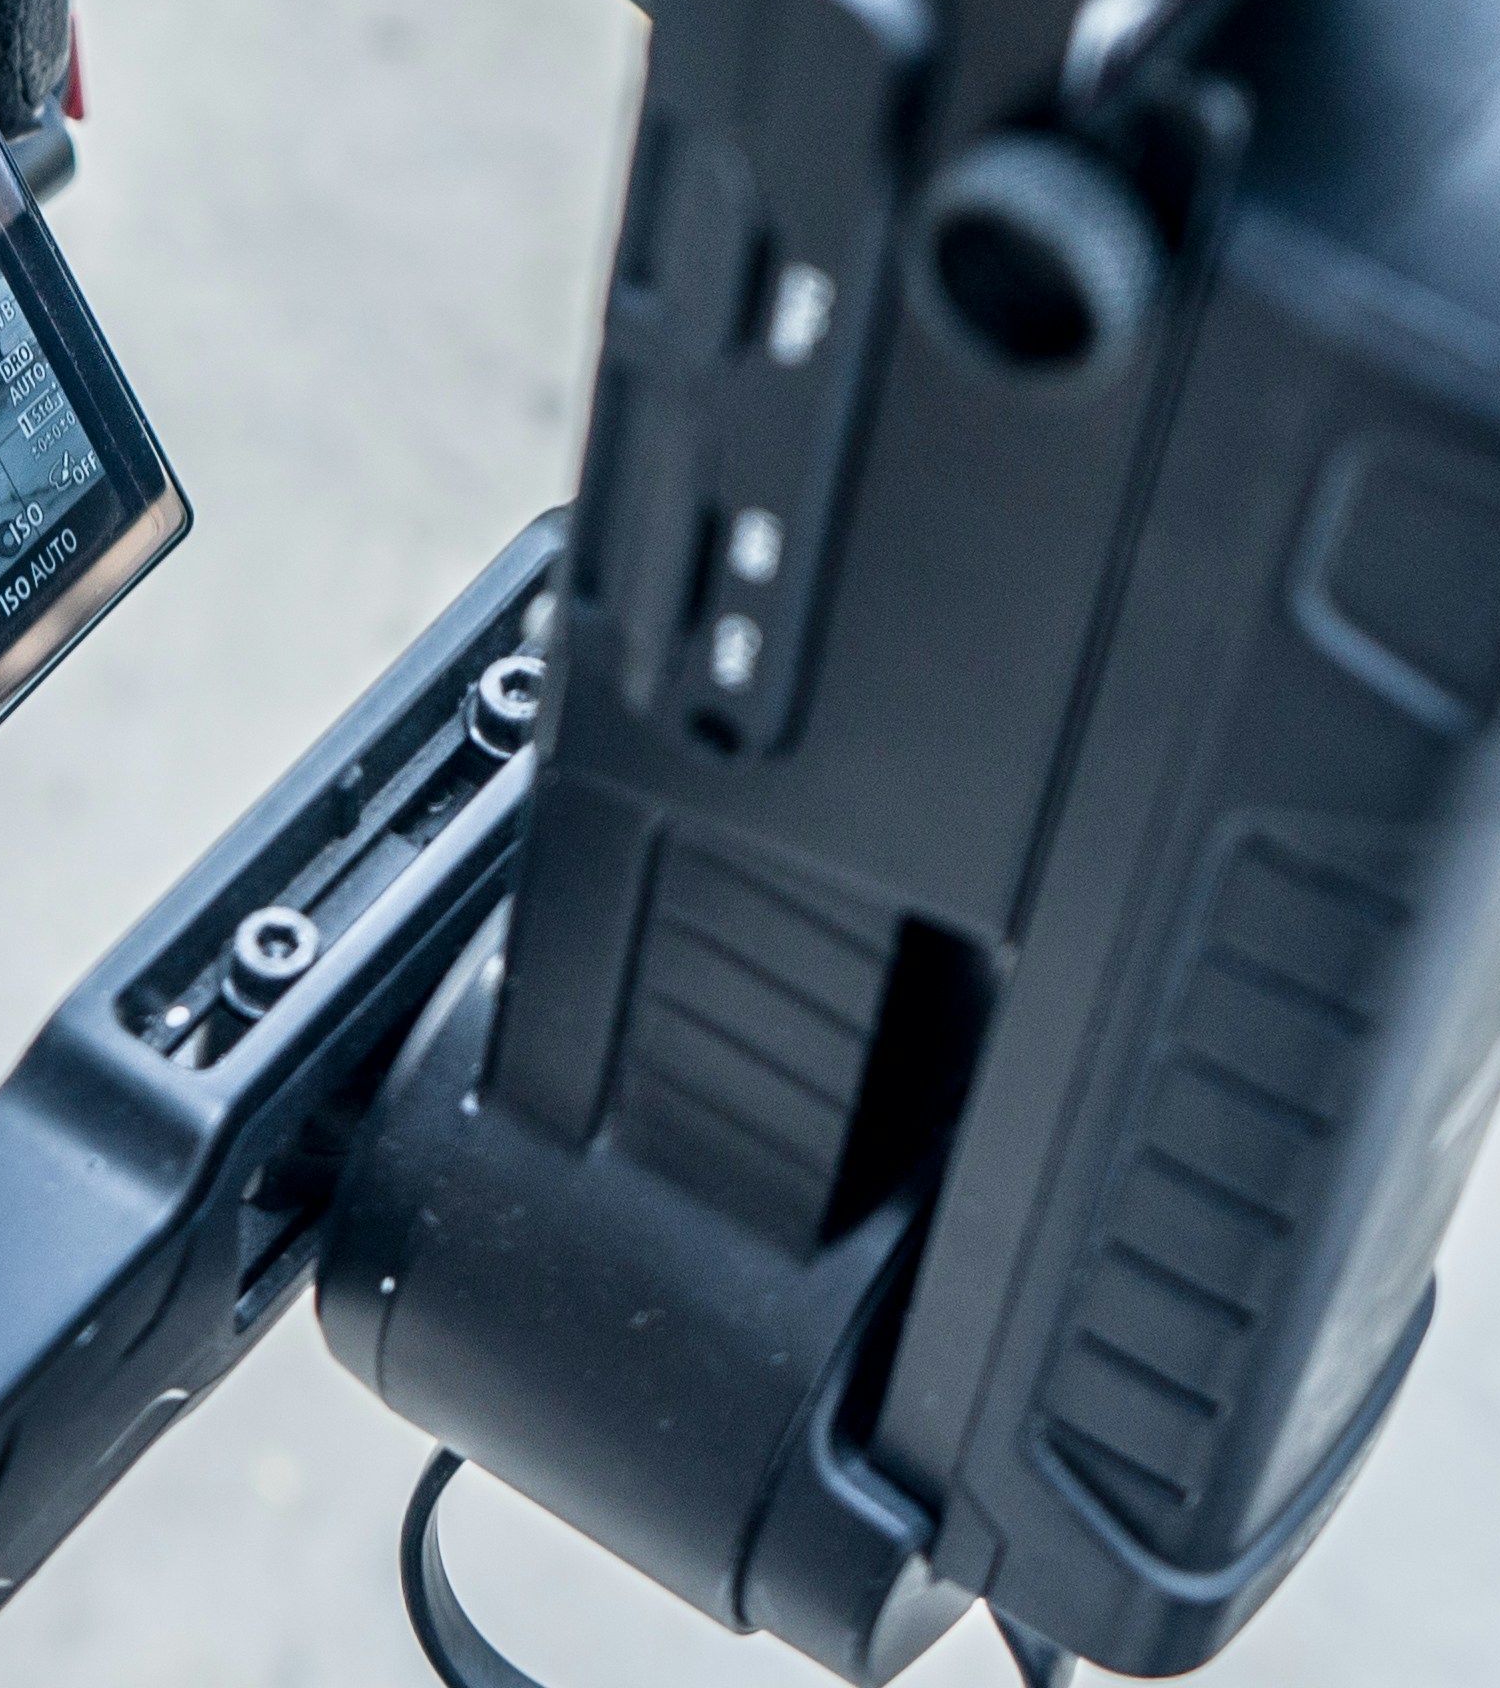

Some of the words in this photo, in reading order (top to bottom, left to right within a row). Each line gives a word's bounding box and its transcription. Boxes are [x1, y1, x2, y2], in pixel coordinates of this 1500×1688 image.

[1, 345, 31, 381] DRO
[8, 362, 46, 407] AUTO
[71, 449, 100, 485] OFF
[8, 501, 45, 546] ISO
[29, 527, 78, 589] AUTO
